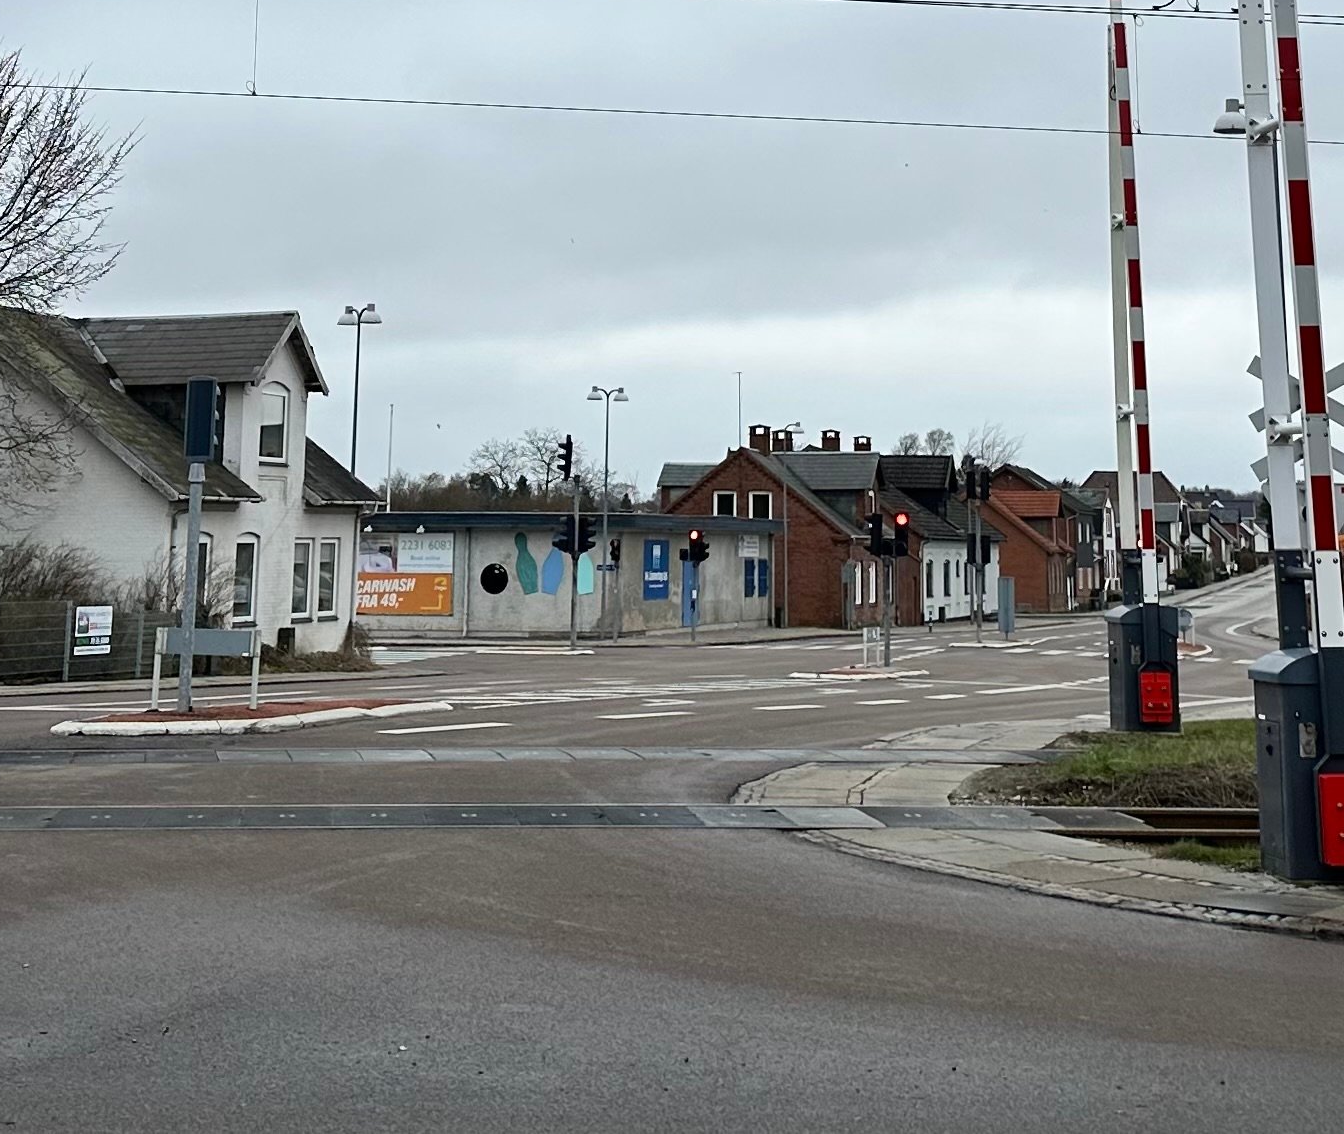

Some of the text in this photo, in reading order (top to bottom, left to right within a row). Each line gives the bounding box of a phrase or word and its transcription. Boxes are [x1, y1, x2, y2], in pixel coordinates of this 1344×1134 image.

[401, 539, 452, 551] 2231 6083
[357, 577, 416, 594] CARWASH
[357, 593, 404, 609] FRA 49,-
